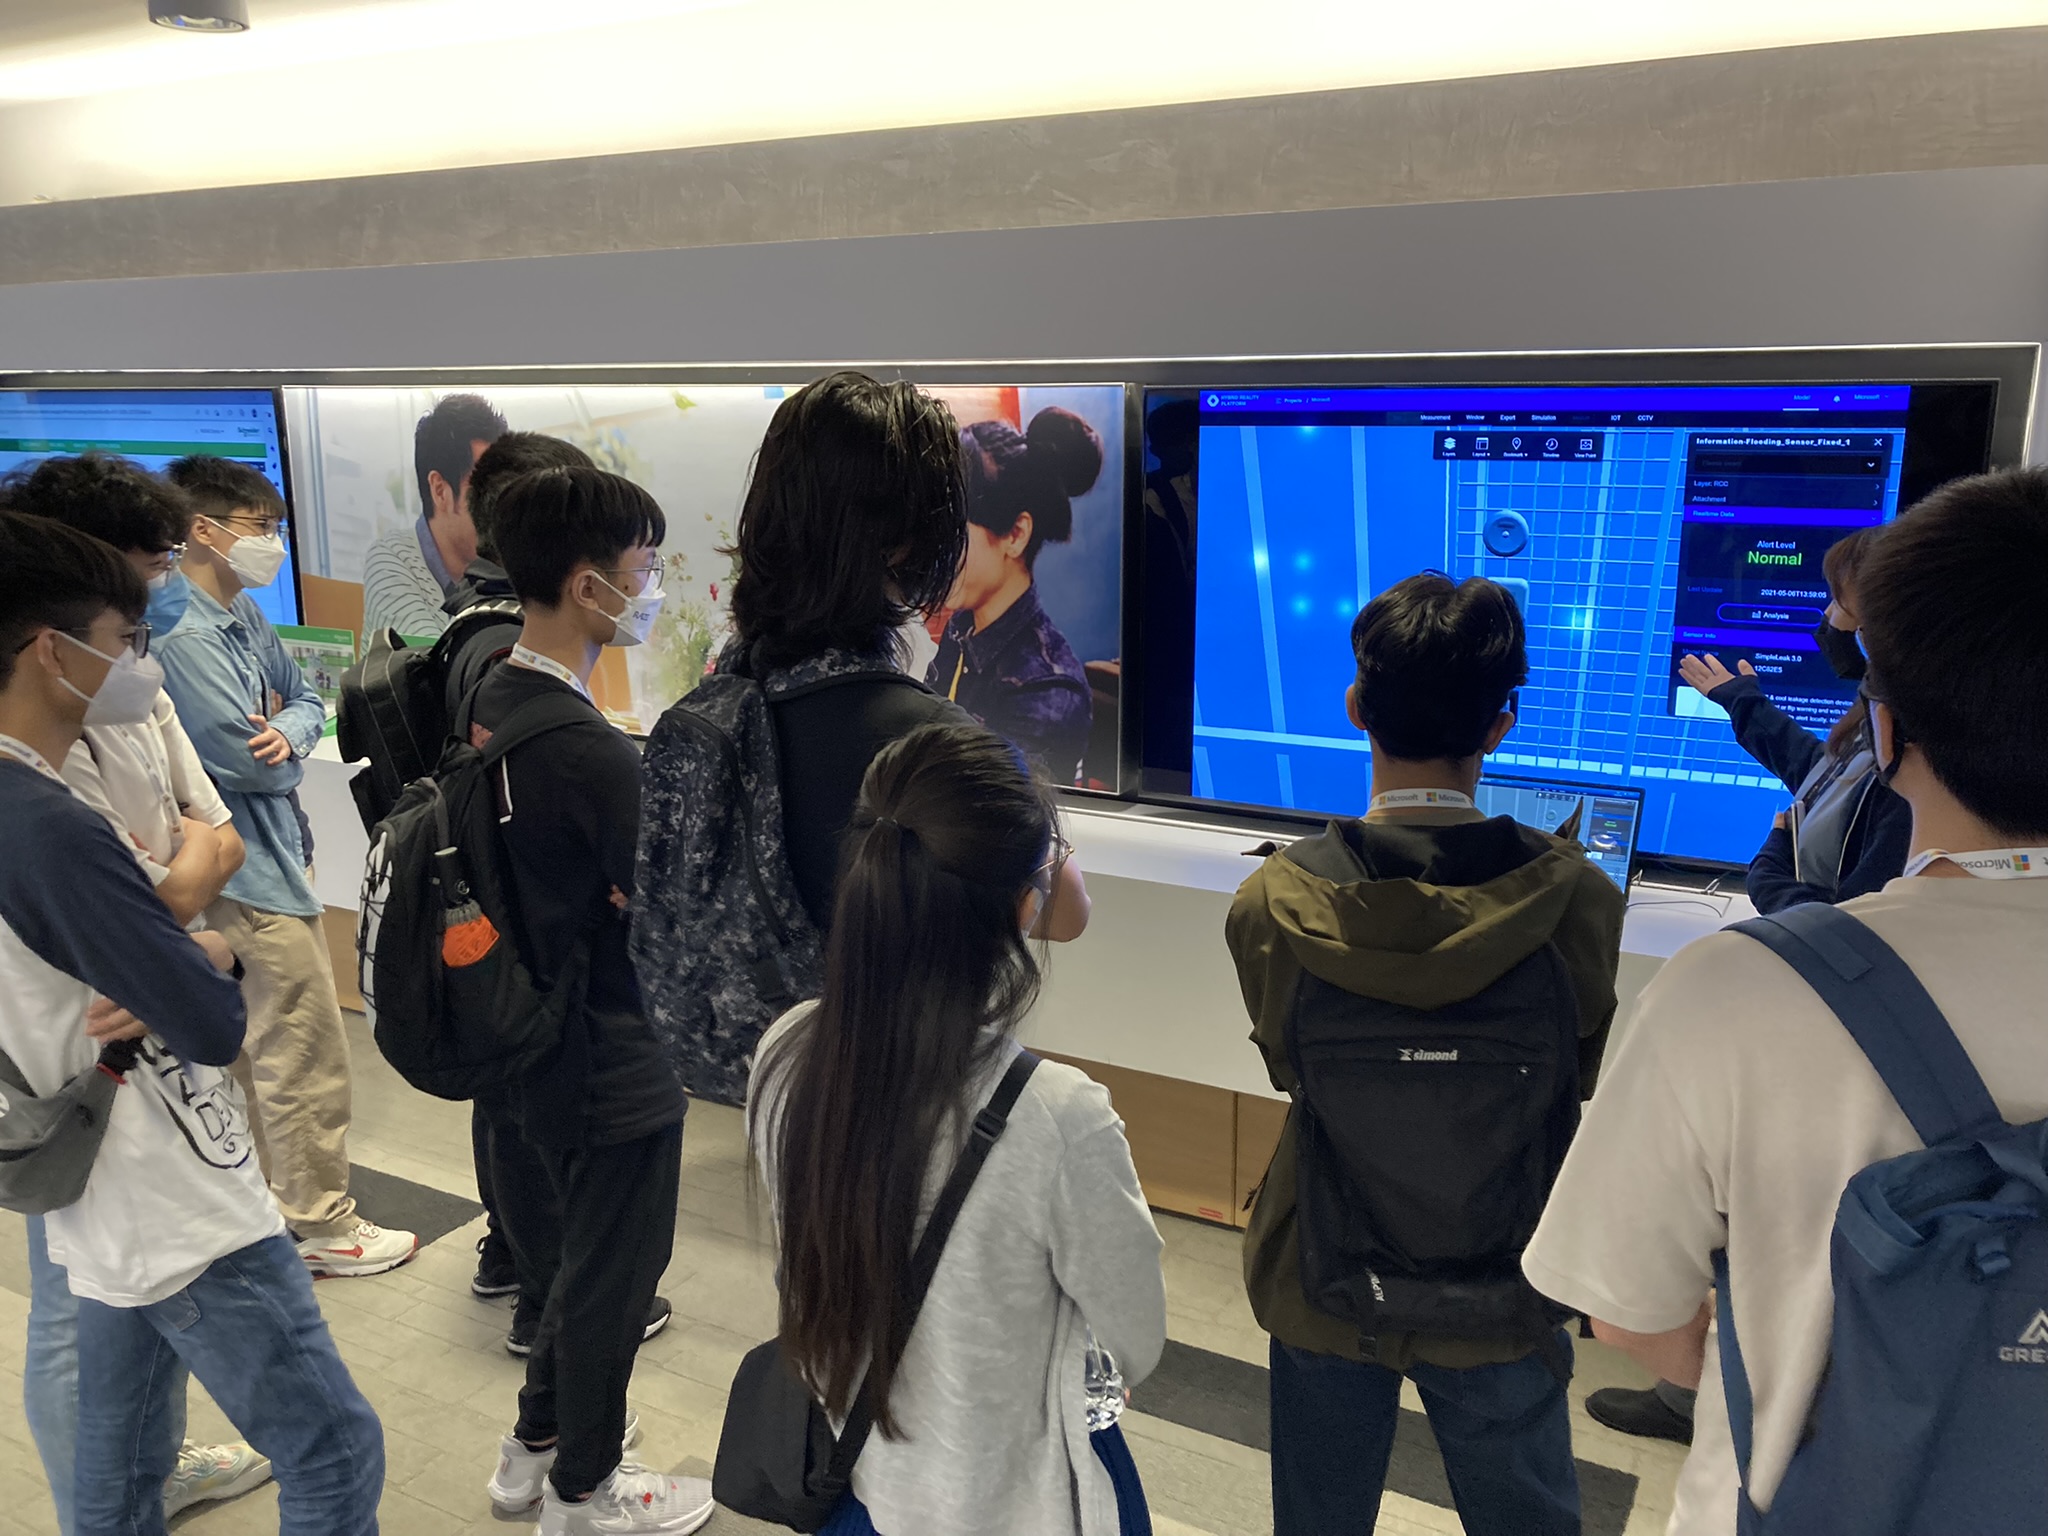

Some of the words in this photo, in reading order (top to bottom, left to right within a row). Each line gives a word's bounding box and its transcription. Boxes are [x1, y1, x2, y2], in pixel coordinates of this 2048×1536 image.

[1692, 495, 1727, 503] Attachment
[1756, 540, 1775, 549] Alert
[1775, 541, 1796, 549] Level
[1748, 550, 1802, 566] Normal
[1763, 611, 1789, 620] Analysis
[1788, 696, 1808, 704] leakage
[1387, 793, 1419, 801] Microsoft
[1413, 1048, 1458, 1061] simond
[1999, 1346, 2048, 1364] GRE
